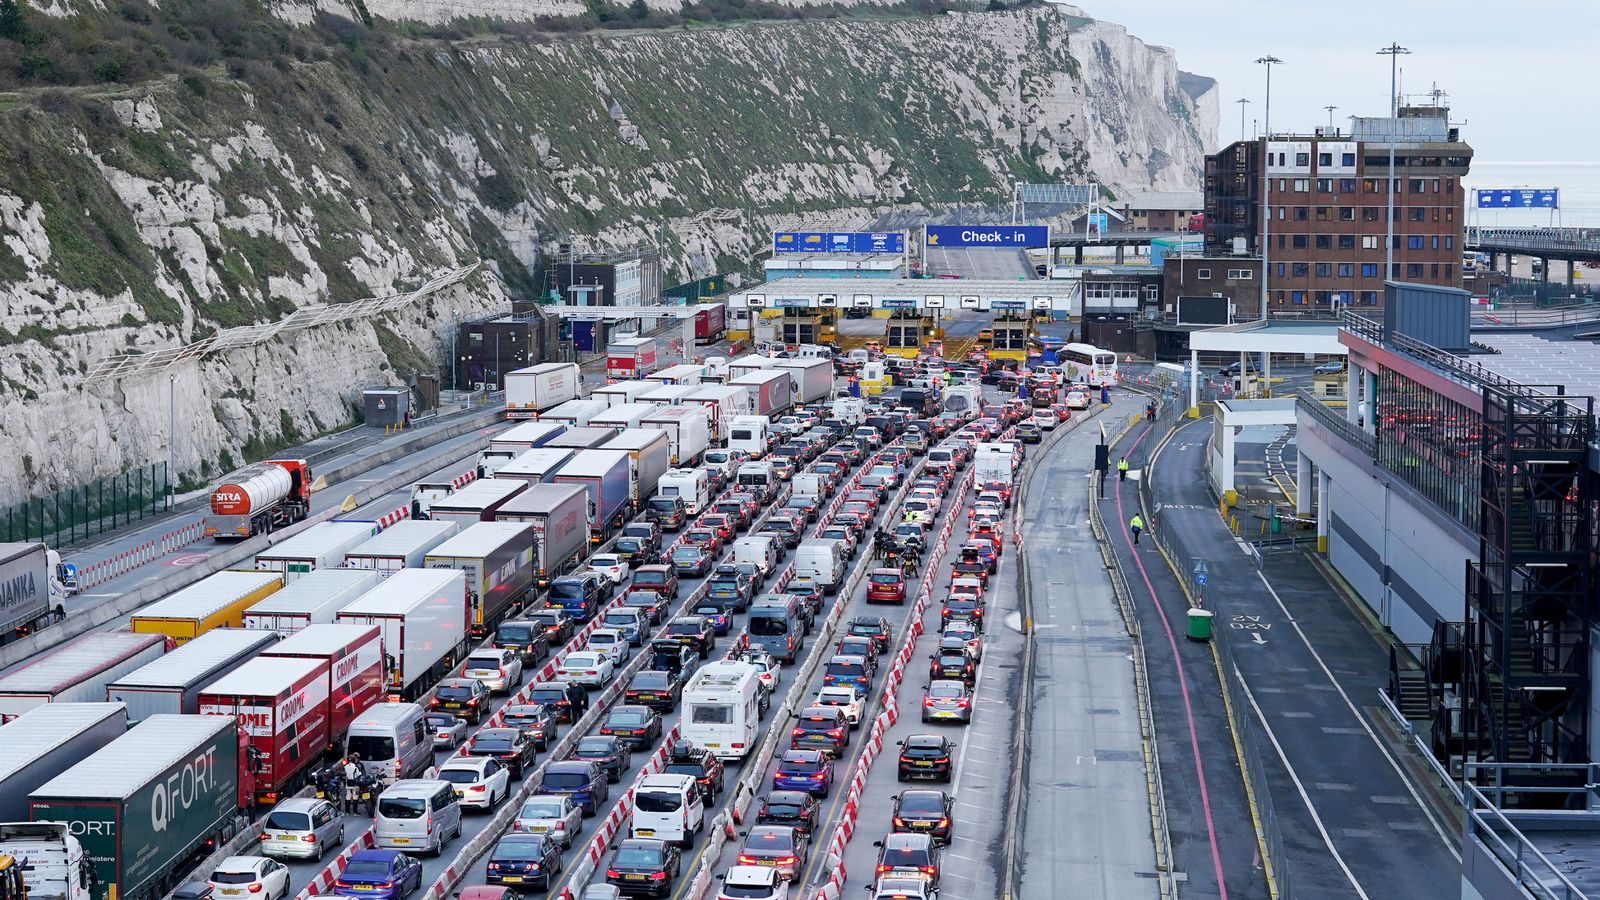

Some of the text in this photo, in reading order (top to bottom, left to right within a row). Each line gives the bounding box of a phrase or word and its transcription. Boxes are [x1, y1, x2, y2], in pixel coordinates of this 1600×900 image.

[961, 231, 1002, 242] Check
[1014, 231, 1026, 242] in
[216, 492, 241, 501] SITRA
[1231, 614, 1260, 622] A2
[1230, 622, 1271, 630] A20
[336, 652, 359, 682] CROOME
[281, 691, 306, 726] CROOME
